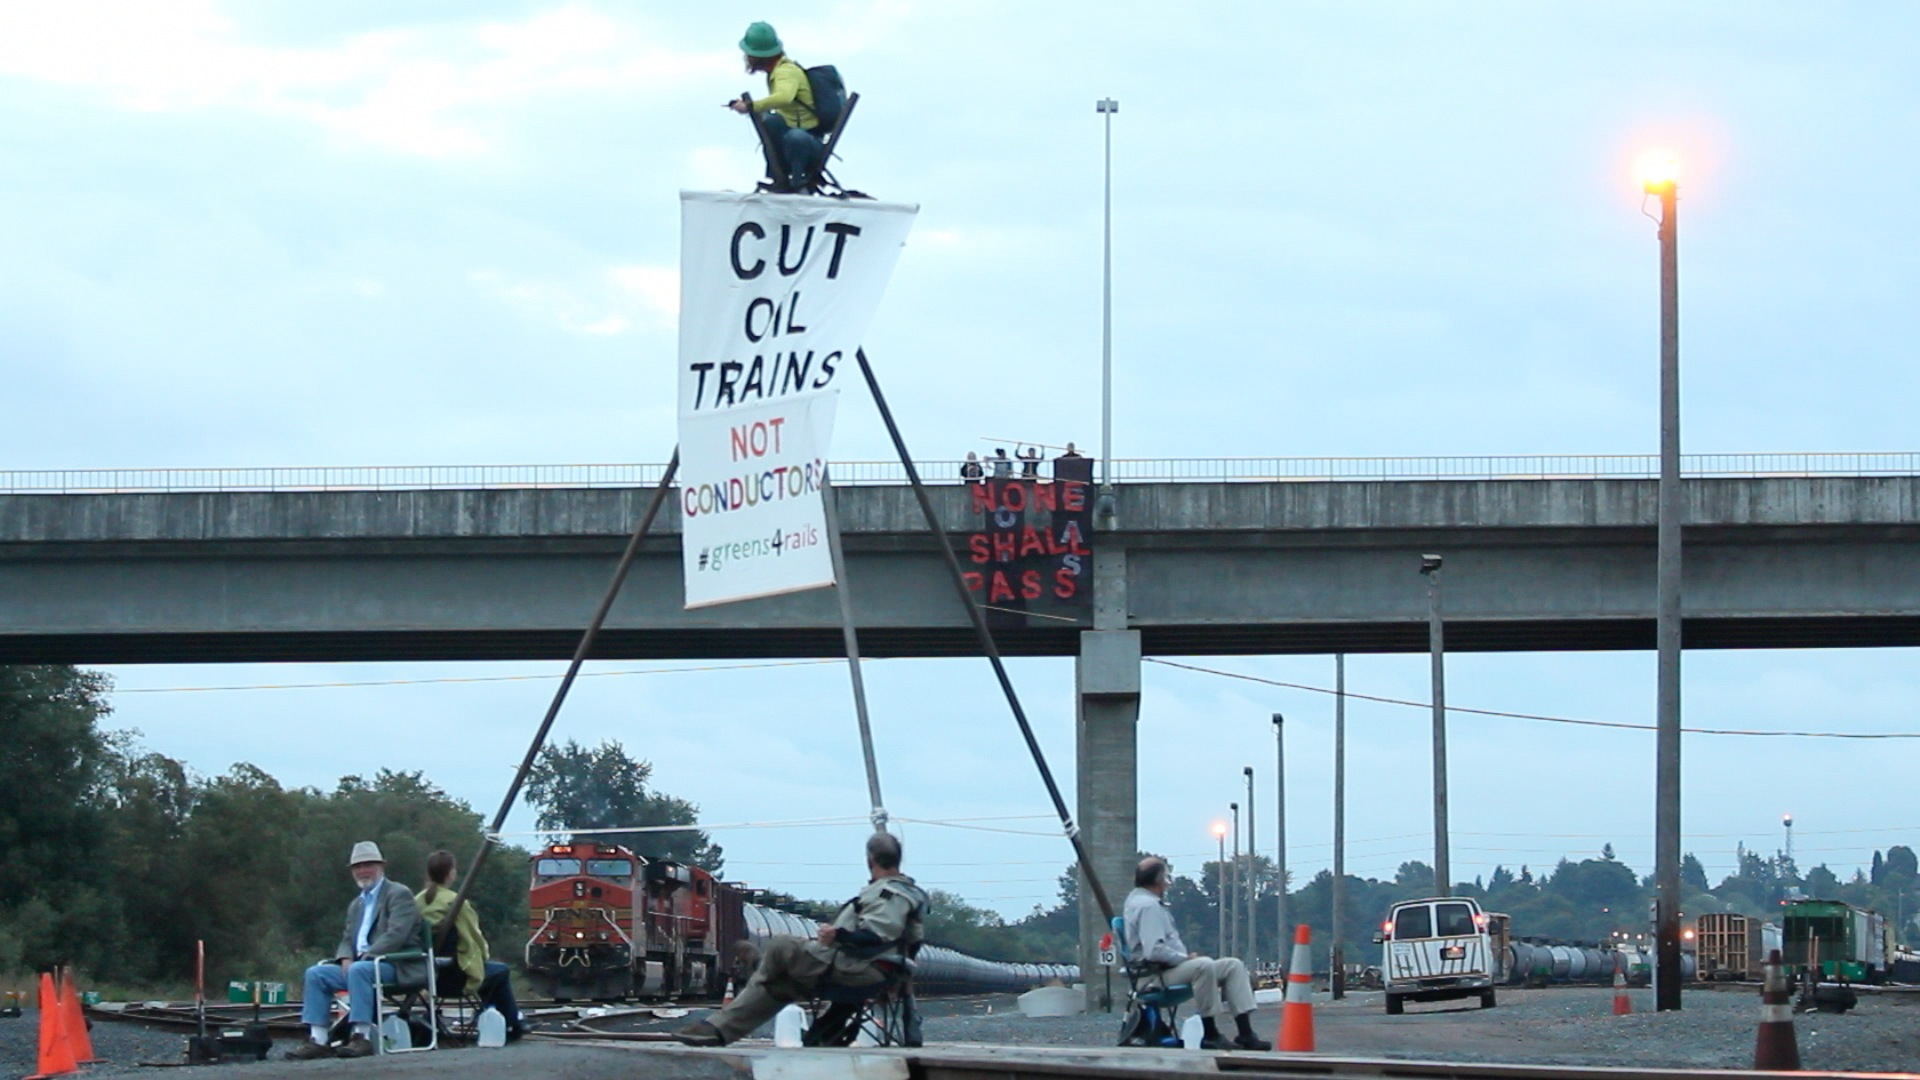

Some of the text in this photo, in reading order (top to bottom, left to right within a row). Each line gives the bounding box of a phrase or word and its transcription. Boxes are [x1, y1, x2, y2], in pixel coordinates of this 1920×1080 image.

[730, 221, 861, 280] CUT
[744, 291, 806, 343] OIL
[690, 350, 842, 411] TRAINS
[730, 417, 784, 462] NOT
[684, 458, 822, 517] CONDUCTORS
[971, 482, 1085, 514] NONE
[698, 523, 818, 572] #greens4rails
[969, 525, 1091, 564] SHALL
[1101, 952, 1114, 963] 10
